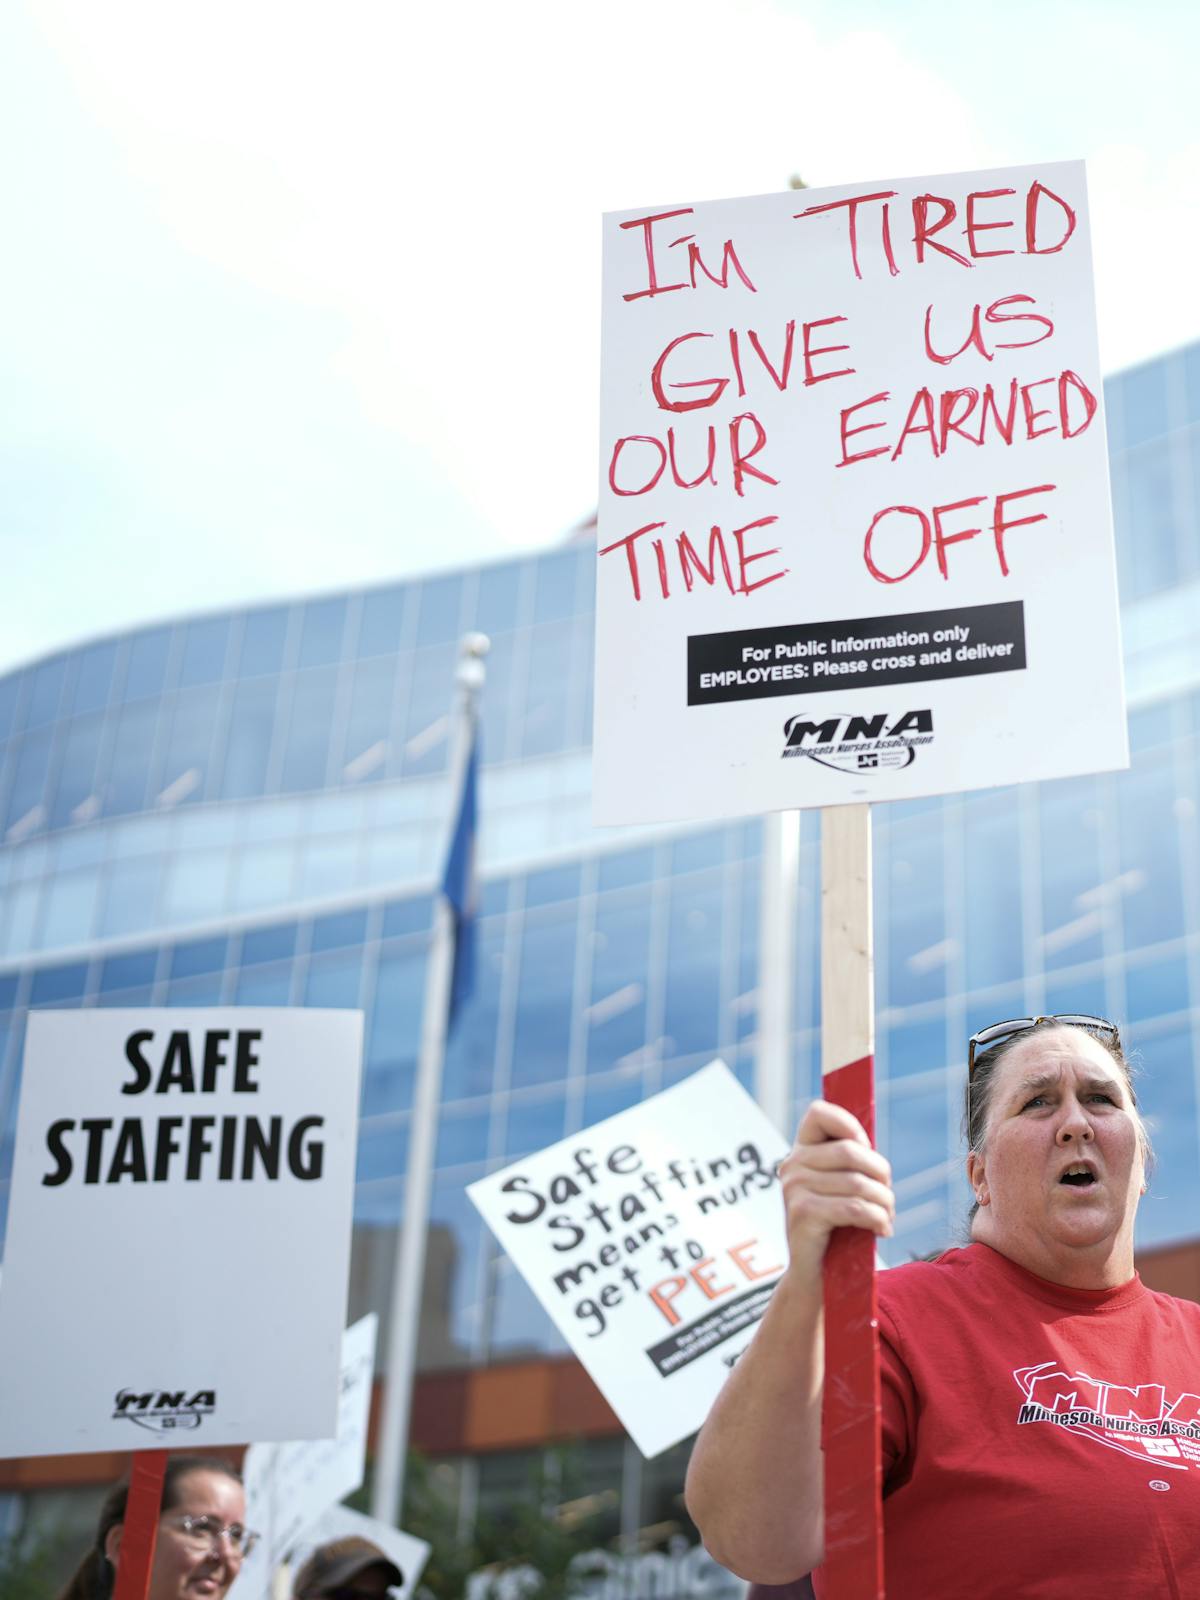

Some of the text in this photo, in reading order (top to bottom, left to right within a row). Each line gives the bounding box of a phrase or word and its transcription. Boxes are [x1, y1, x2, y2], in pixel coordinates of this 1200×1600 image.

[793, 180, 1076, 279] TIRED
[652, 294, 1054, 412] GIVE US
[609, 370, 1097, 497] OUR EARNED
[598, 484, 1056, 601] TIME OFF
[700, 642, 1014, 688] EMPLOYEES: Please cross and deliver
[742, 625, 970, 663] For Public Information only
[786, 709, 933, 746] MNA
[121, 1029, 262, 1095] SAFE
[42, 1115, 325, 1188] STAFFING
[501, 1144, 643, 1225] Safe
[547, 1142, 763, 1252] Staffing
[553, 1212, 679, 1295] means
[574, 1266, 642, 1338] get
[659, 1239, 704, 1270] to
[647, 1238, 786, 1326] PEE
[117, 1390, 215, 1410] MNA
[1017, 1404, 1103, 1427] Minnesota
[1106, 1417, 1157, 1436] Nurses
